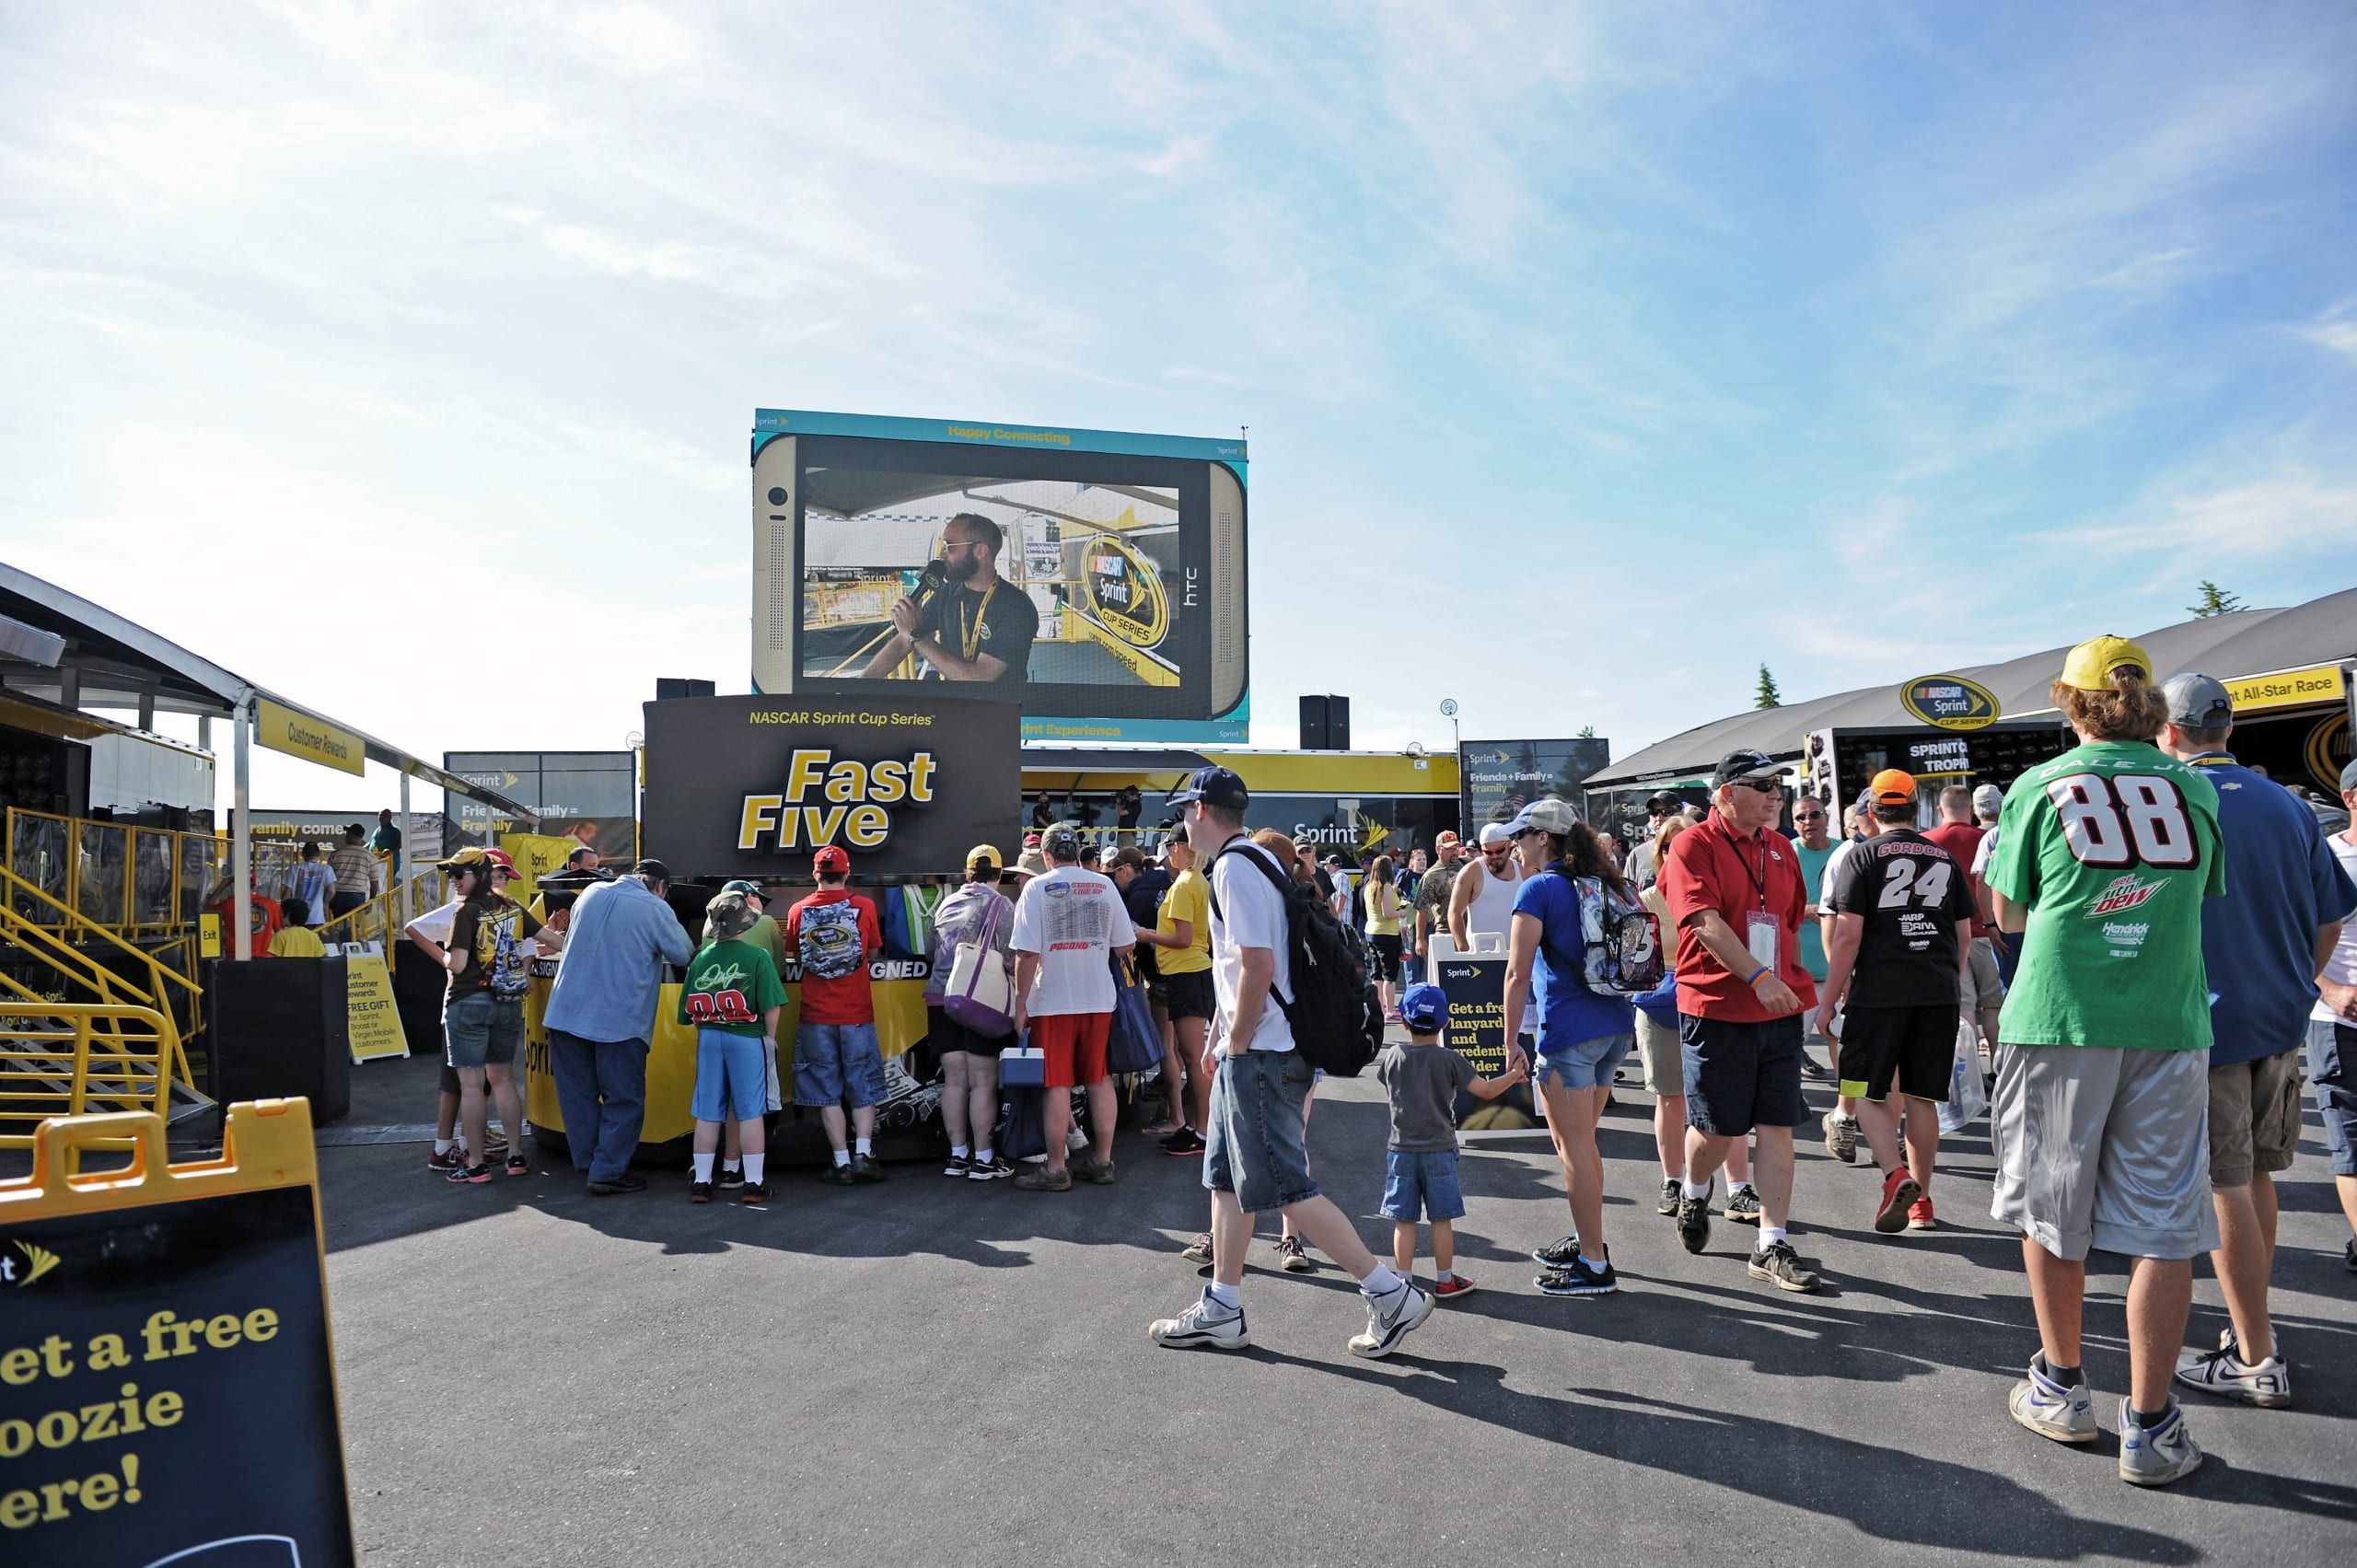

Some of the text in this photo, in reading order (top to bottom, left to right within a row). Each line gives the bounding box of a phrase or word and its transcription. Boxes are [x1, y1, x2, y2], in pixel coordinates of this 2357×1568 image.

[948, 425, 1071, 446] Happy Connecting
[1217, 447, 1237, 455] Sprint
[1100, 577, 1127, 604] Sprint
[1103, 611, 1150, 641] CUP SERIES
[1928, 686, 1962, 698] NASCAR
[2243, 683, 2293, 701] All-Star
[2296, 679, 2333, 692] Race
[1934, 700, 1968, 714] Sprint
[749, 712, 809, 725] NASCAR
[812, 712, 855, 728] Sprint
[858, 712, 888, 727] Cup
[1020, 723, 1121, 737] rint Experience
[1219, 730, 1239, 738] Sprint
[288, 722, 347, 761] Customer Rewards
[1910, 741, 1958, 757] SPRINT
[1469, 754, 1497, 765] Sprint
[785, 749, 937, 803] Fast
[2039, 759, 2136, 780] DALE
[1469, 772, 1507, 782] Friends
[1515, 772, 1546, 782] Family
[1470, 784, 1507, 794] Framily
[461, 819, 513, 833] Fraily
[738, 795, 890, 849] Five
[2046, 772, 2200, 870] 88
[250, 820, 349, 837] ramily come
[1295, 823, 1358, 845] Sprint
[1877, 842, 1950, 859] GORDON
[531, 853, 547, 868] Sprint
[1878, 857, 1951, 909] 24
[203, 930, 216, 939] Exit
[2102, 922, 2150, 935] Hendrick
[1049, 942, 1089, 952] POCONO
[1633, 923, 1655, 963] 5
[348, 971, 363, 980] rint
[539, 961, 558, 977] SIGN
[868, 961, 928, 978] GNED
[1447, 969, 1470, 978] Sprint
[348, 981, 378, 989] ustomer
[348, 989, 376, 998] ewards
[348, 1000, 389, 1012] FREE GIFT
[1448, 1002, 1504, 1014] Get a fre
[350, 1022, 370, 1030] Boost
[1450, 1016, 1504, 1030] lanyard
[353, 1028, 396, 1040] Virgin Mobile
[1451, 1032, 1478, 1044] and
[526, 1028, 554, 1083] pri
[1455, 1044, 1507, 1057] redenti
[0, 1307, 279, 1386] et a free
[0, 1383, 184, 1458] oozie
[0, 1453, 142, 1528] ere!
